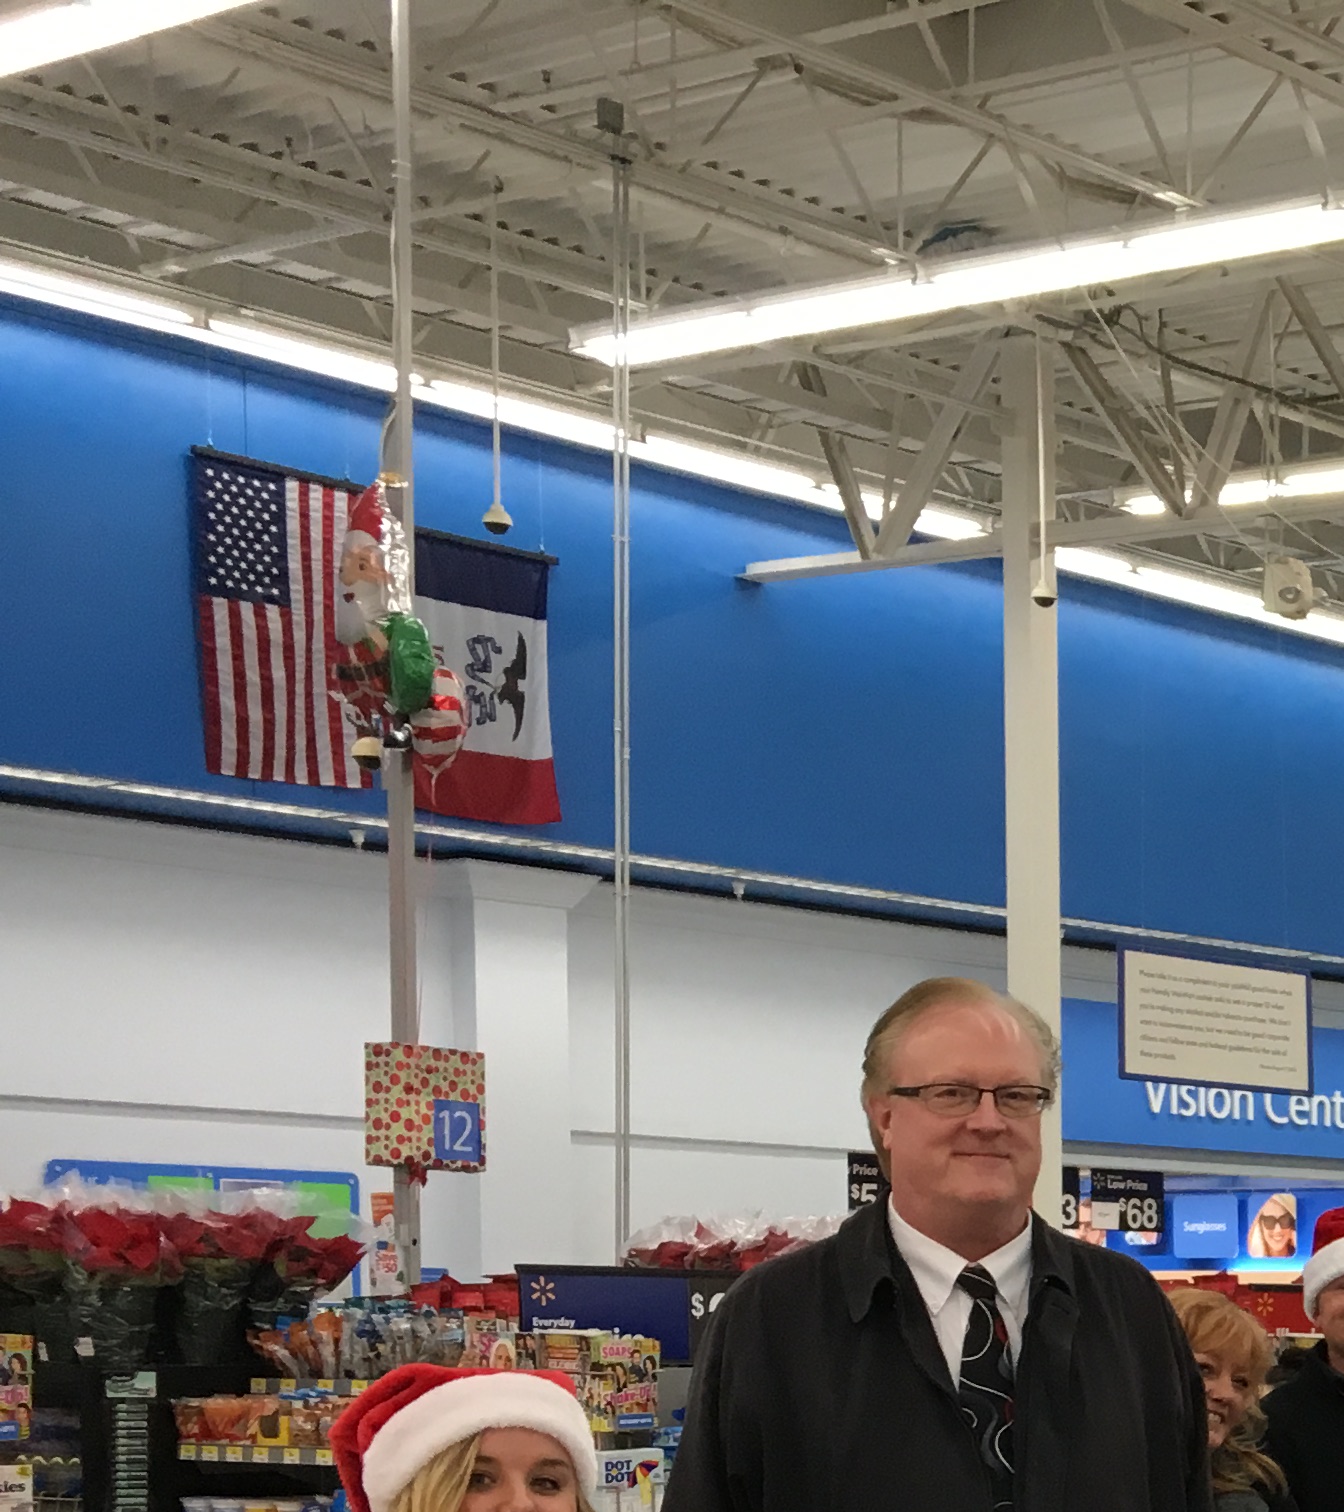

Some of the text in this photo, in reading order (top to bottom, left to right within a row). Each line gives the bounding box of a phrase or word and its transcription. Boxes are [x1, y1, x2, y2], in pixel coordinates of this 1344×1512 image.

[1144, 1080, 1255, 1122] Vision
[438, 1109, 474, 1152] 12
[1119, 1196, 1158, 1230] $68
[532, 1316, 576, 1329] Everyday
[604, 1459, 633, 1473] DOT
[604, 1471, 631, 1484] DOT
